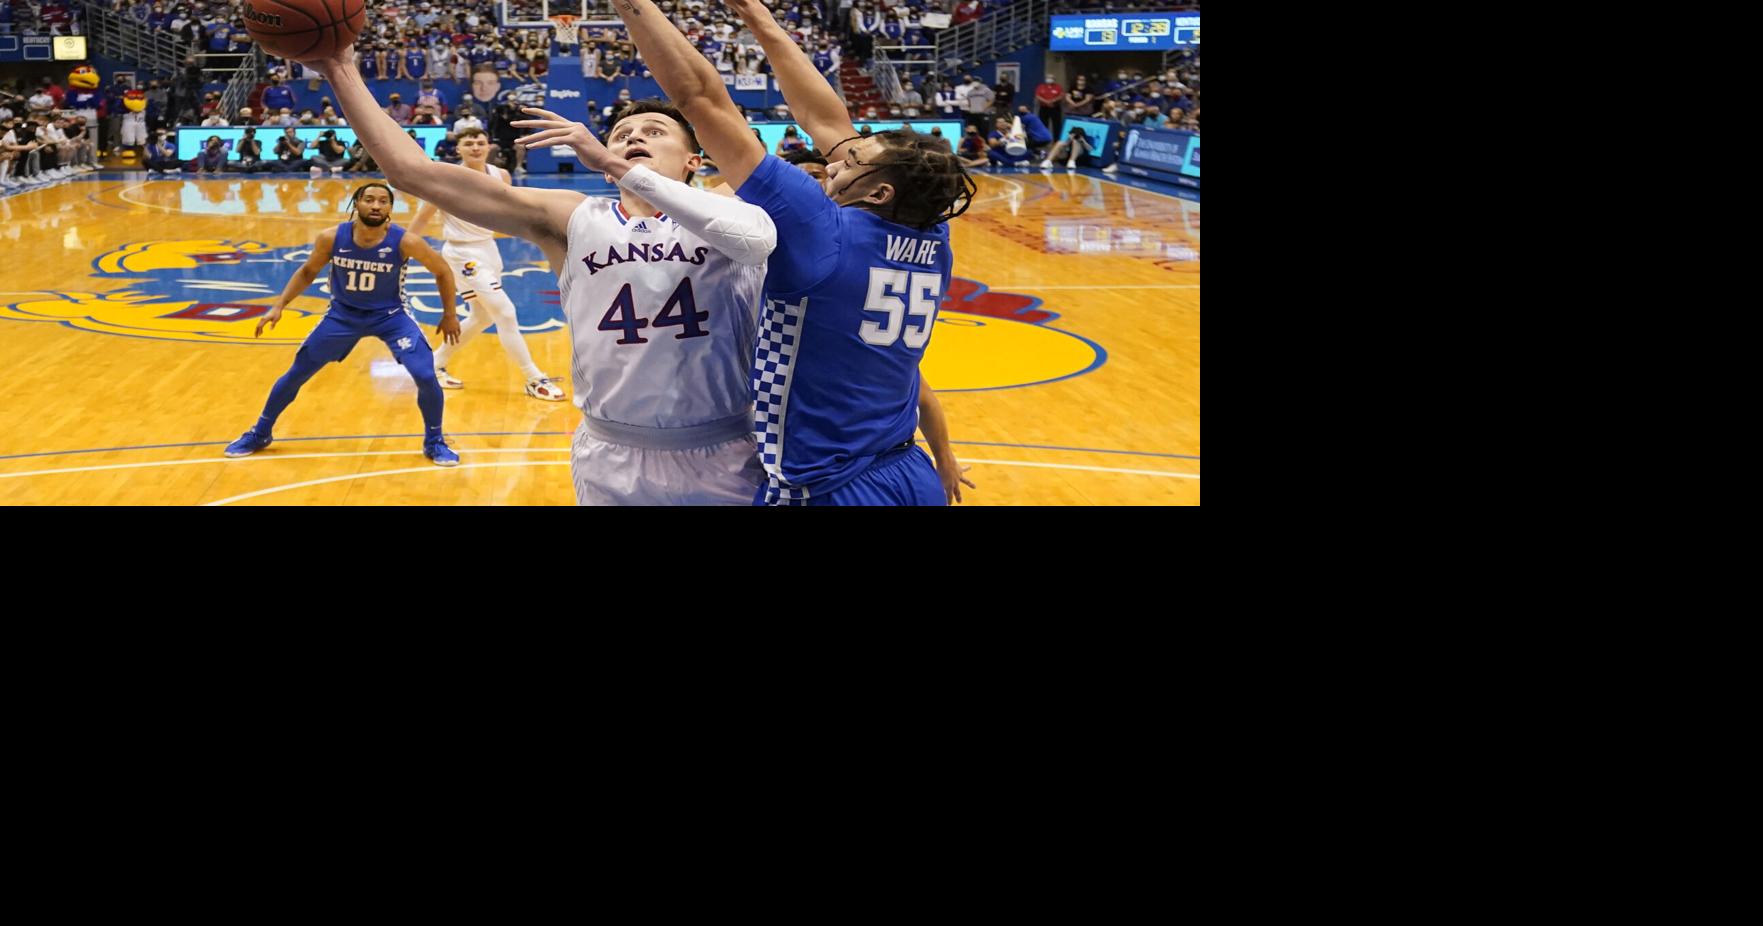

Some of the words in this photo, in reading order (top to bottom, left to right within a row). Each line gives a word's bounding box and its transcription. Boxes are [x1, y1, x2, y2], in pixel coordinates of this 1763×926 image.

[333, 256, 394, 273] KENTUCKY
[582, 242, 709, 275] KANSAS
[886, 234, 941, 265] WARE
[345, 270, 376, 292] 10
[597, 276, 710, 345] 44
[858, 266, 942, 348] 55
